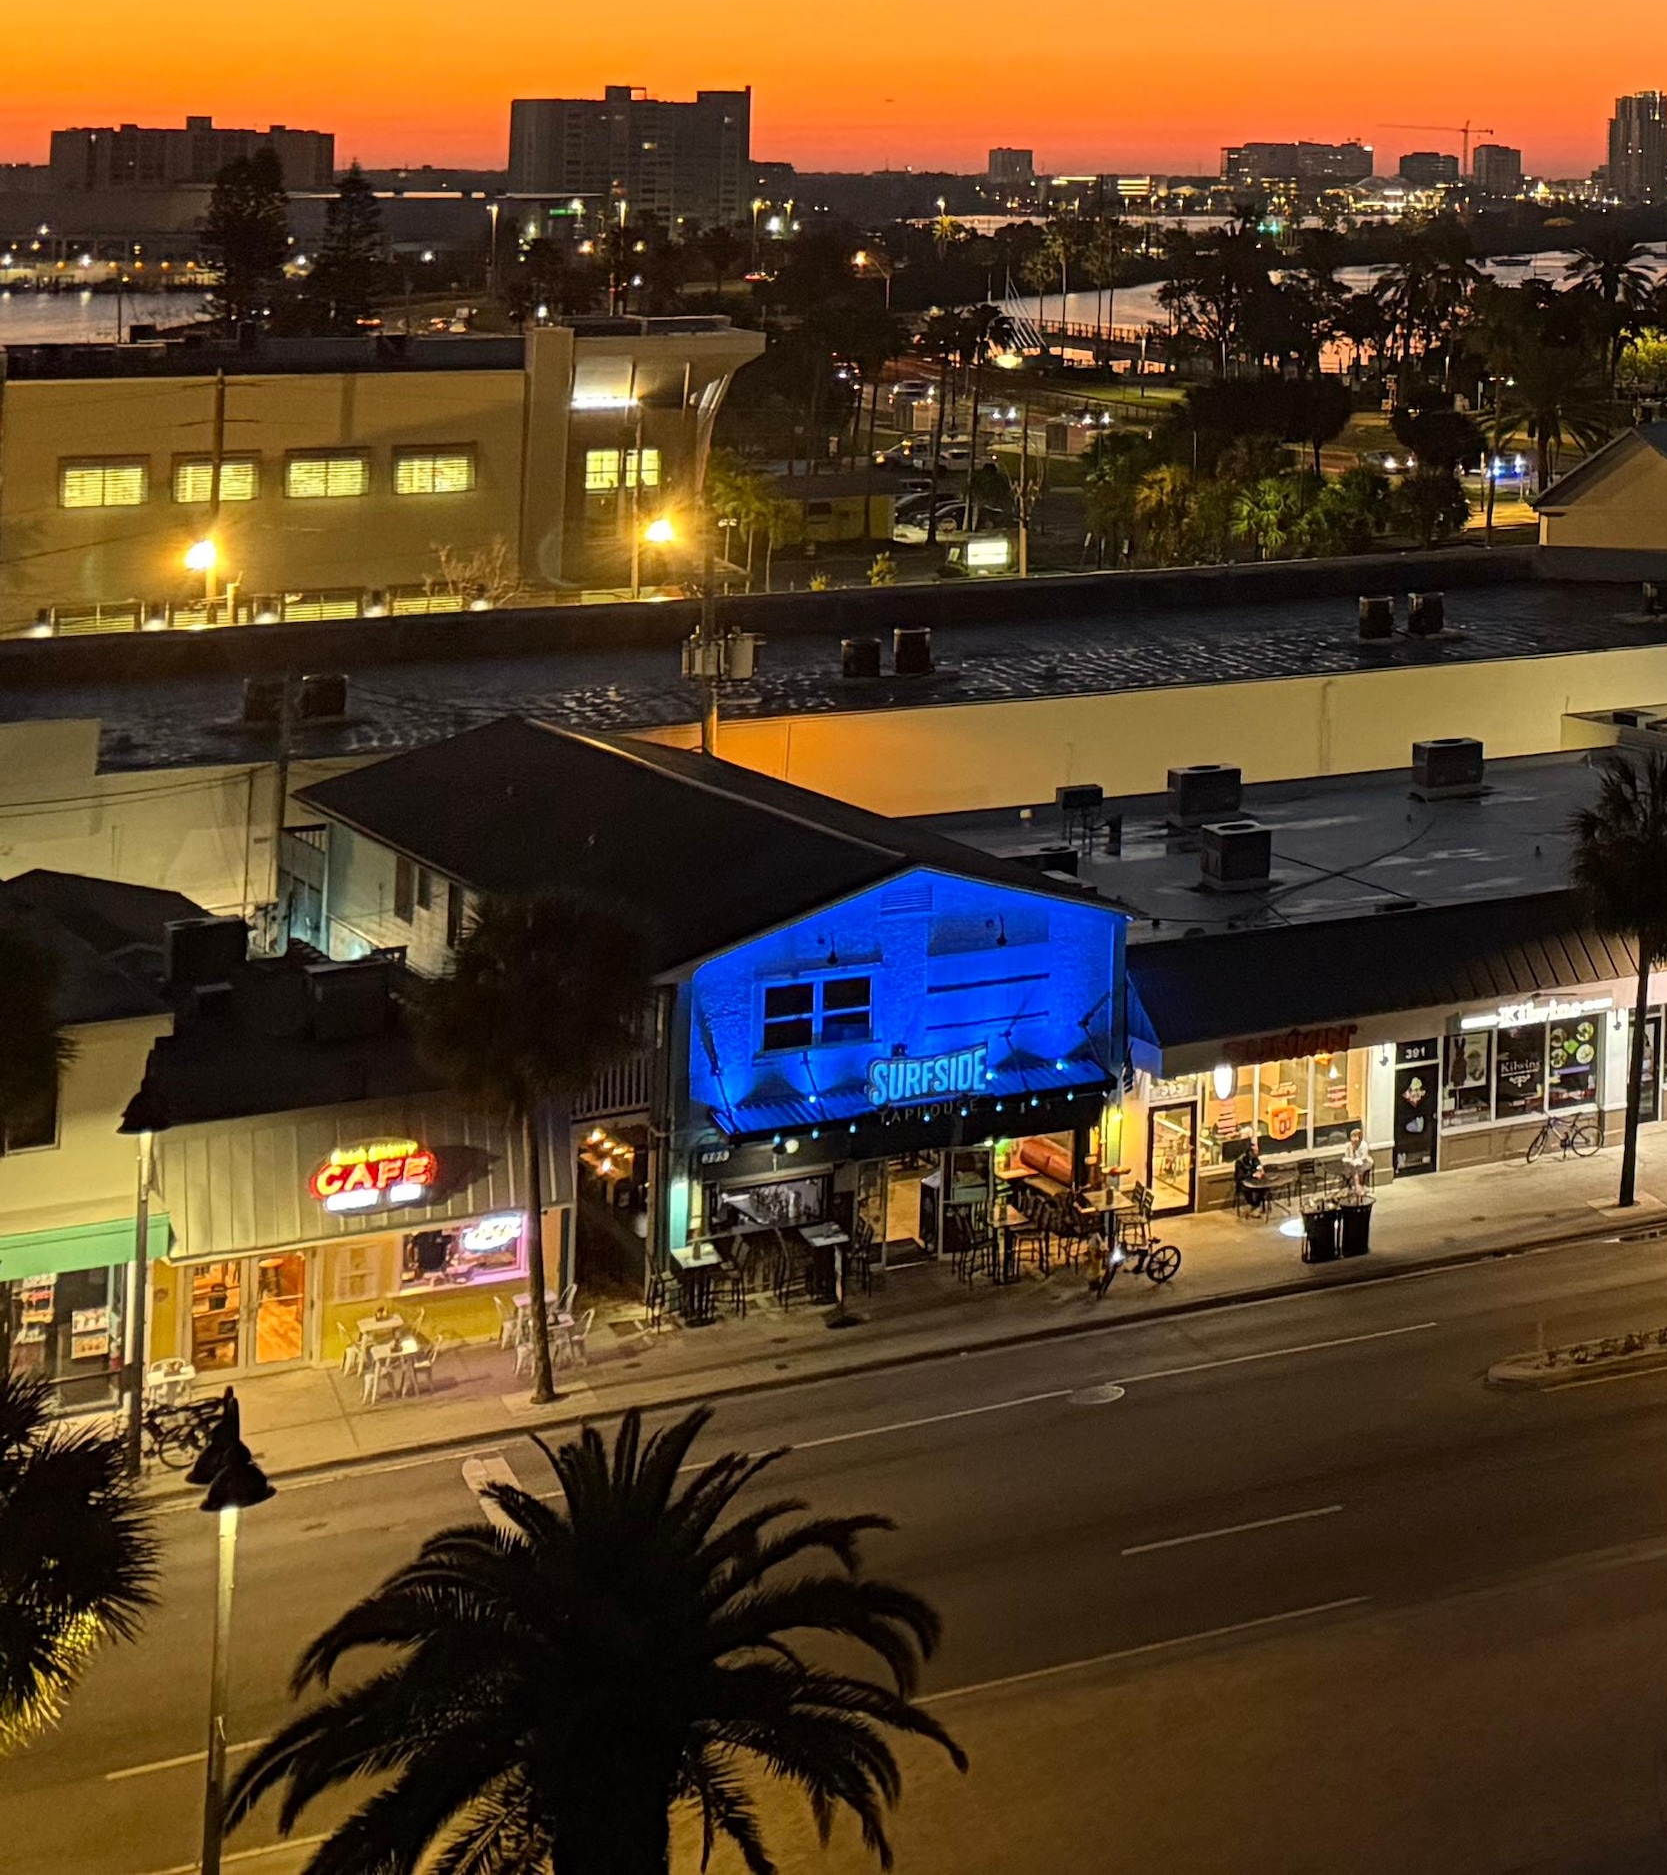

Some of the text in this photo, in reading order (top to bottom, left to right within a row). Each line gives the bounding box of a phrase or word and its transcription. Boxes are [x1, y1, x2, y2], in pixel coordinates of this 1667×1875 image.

[1405, 1046, 1426, 1060] 391
[872, 1047, 987, 1106] SURFSIDE
[1500, 1060, 1541, 1074] Kilwins
[316, 1156, 430, 1196] CAFE
